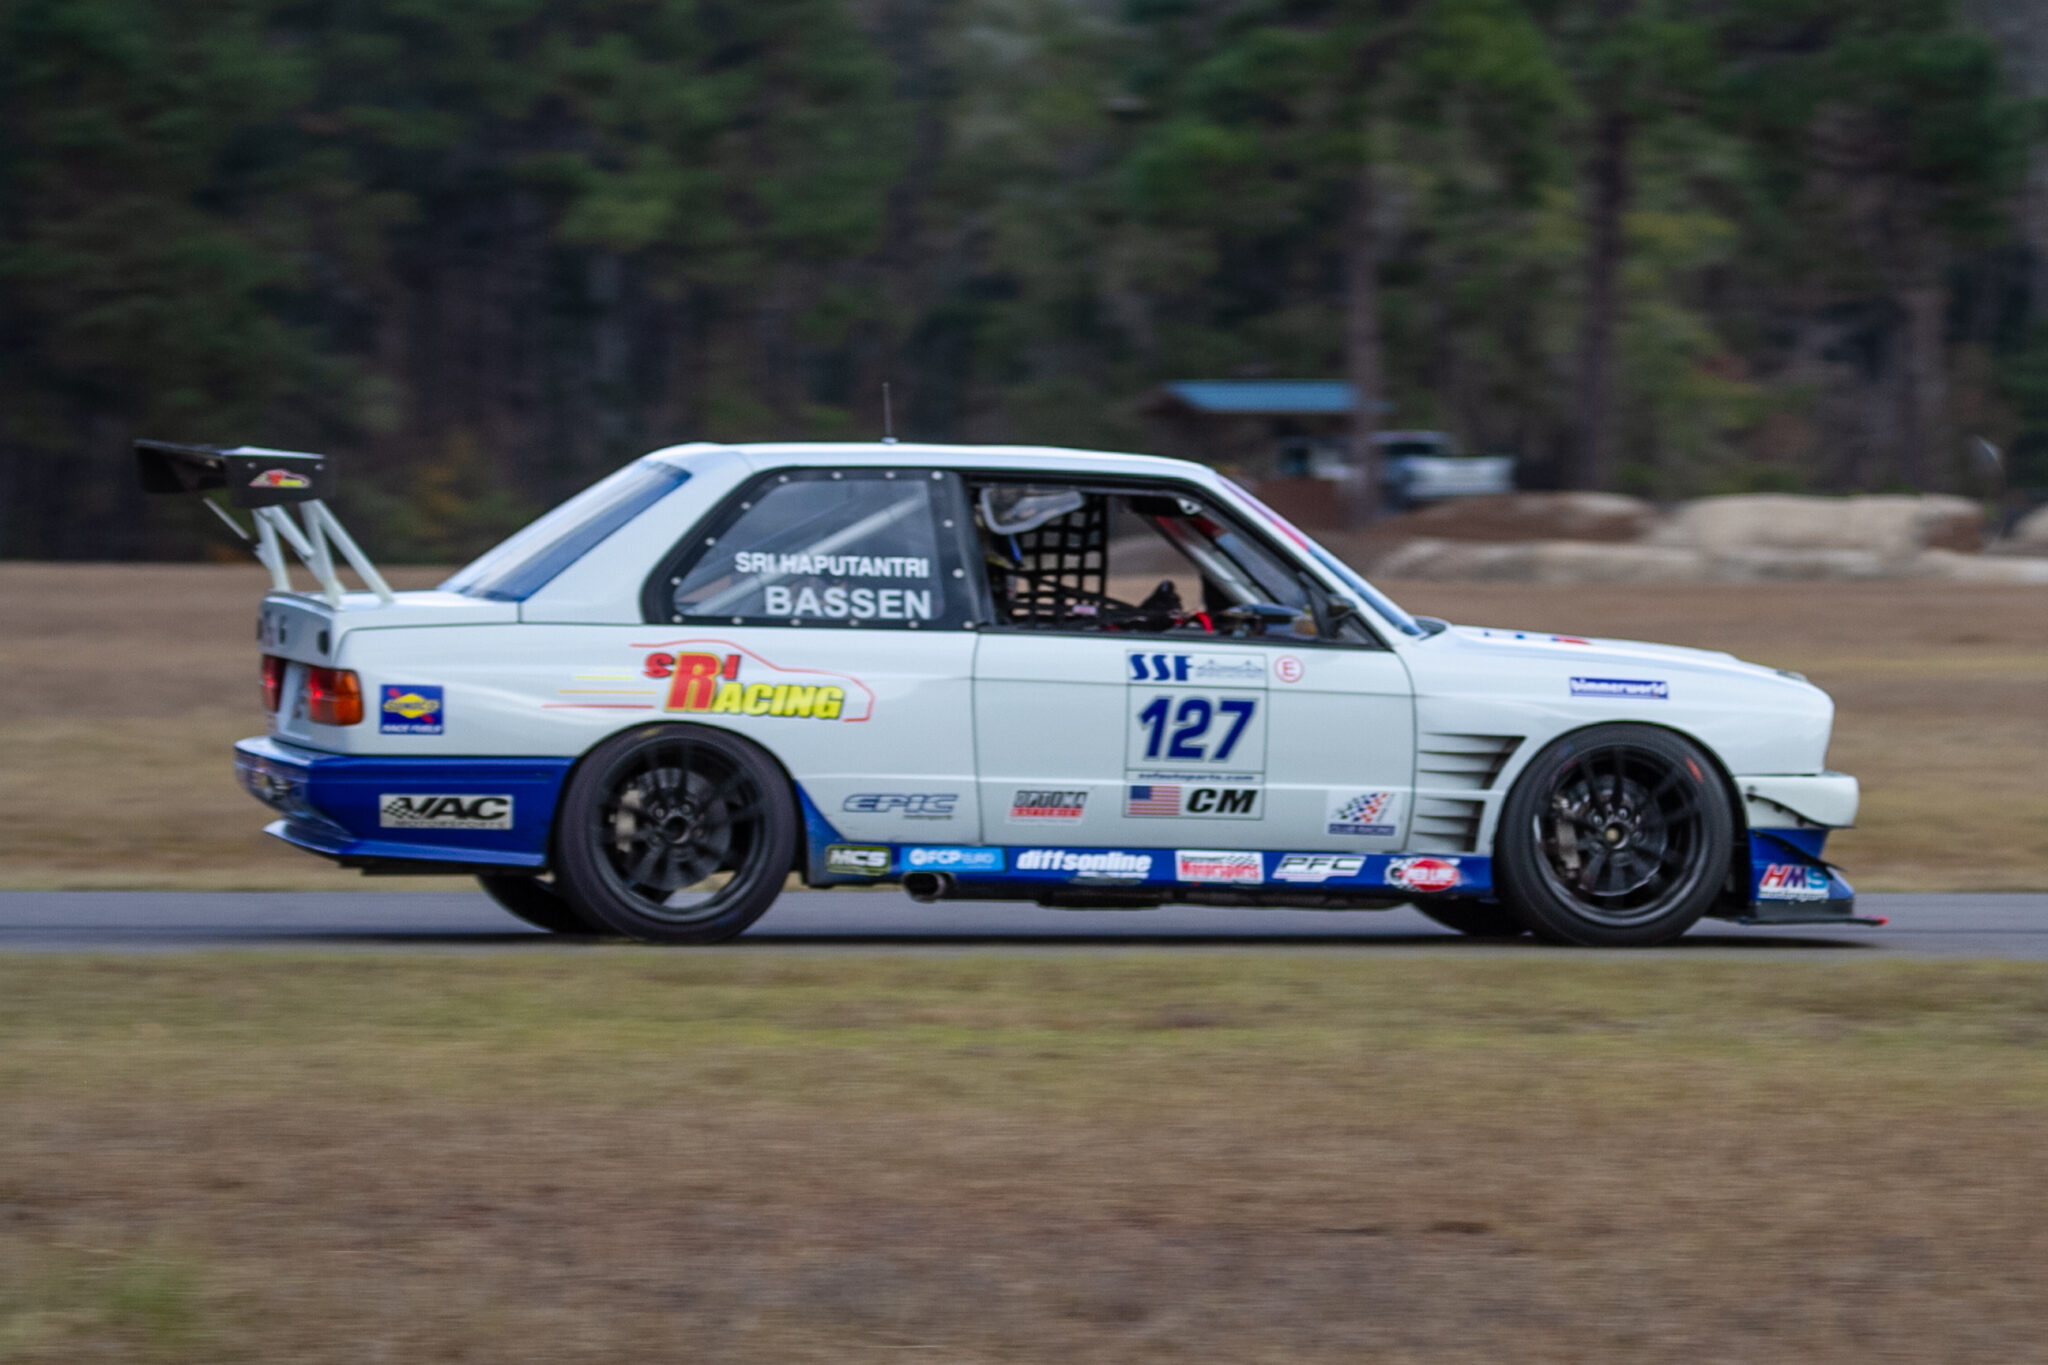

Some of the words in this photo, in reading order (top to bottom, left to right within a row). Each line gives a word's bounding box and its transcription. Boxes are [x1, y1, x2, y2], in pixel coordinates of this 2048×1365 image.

[735, 551, 775, 573] SRI
[780, 553, 930, 578] HAPUTANTRI
[764, 586, 931, 619] BASSEN
[1130, 653, 1193, 682] SSF
[1282, 661, 1295, 677] E
[1138, 696, 1259, 763] 127
[397, 797, 508, 820] VAC
[843, 794, 958, 812] EPIC
[1187, 788, 1257, 813] CM
[829, 849, 887, 866] MCS
[927, 850, 962, 865] FCP
[1016, 850, 1153, 872] diffsonline
[1282, 857, 1362, 870] PFC
[1761, 864, 1828, 889] HMS
